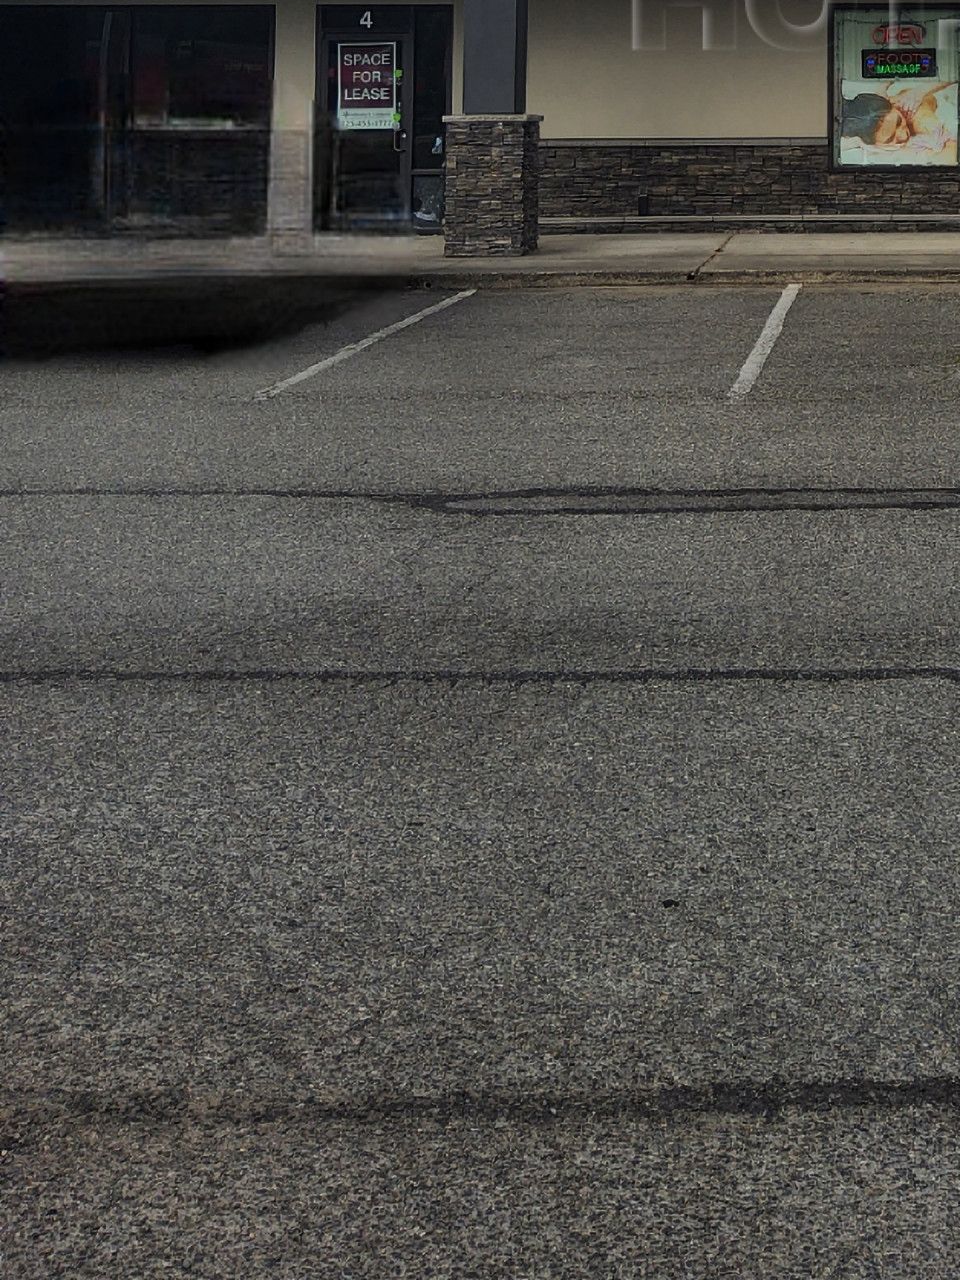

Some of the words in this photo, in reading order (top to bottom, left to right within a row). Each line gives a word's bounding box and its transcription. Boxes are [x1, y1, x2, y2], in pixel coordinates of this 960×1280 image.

[360, 11, 373, 29] 4
[872, 26, 924, 45] OPEN
[344, 54, 390, 66] SPACE
[877, 53, 920, 64] FOOT
[353, 71, 381, 83] FOR
[344, 88, 390, 100] LEASE
